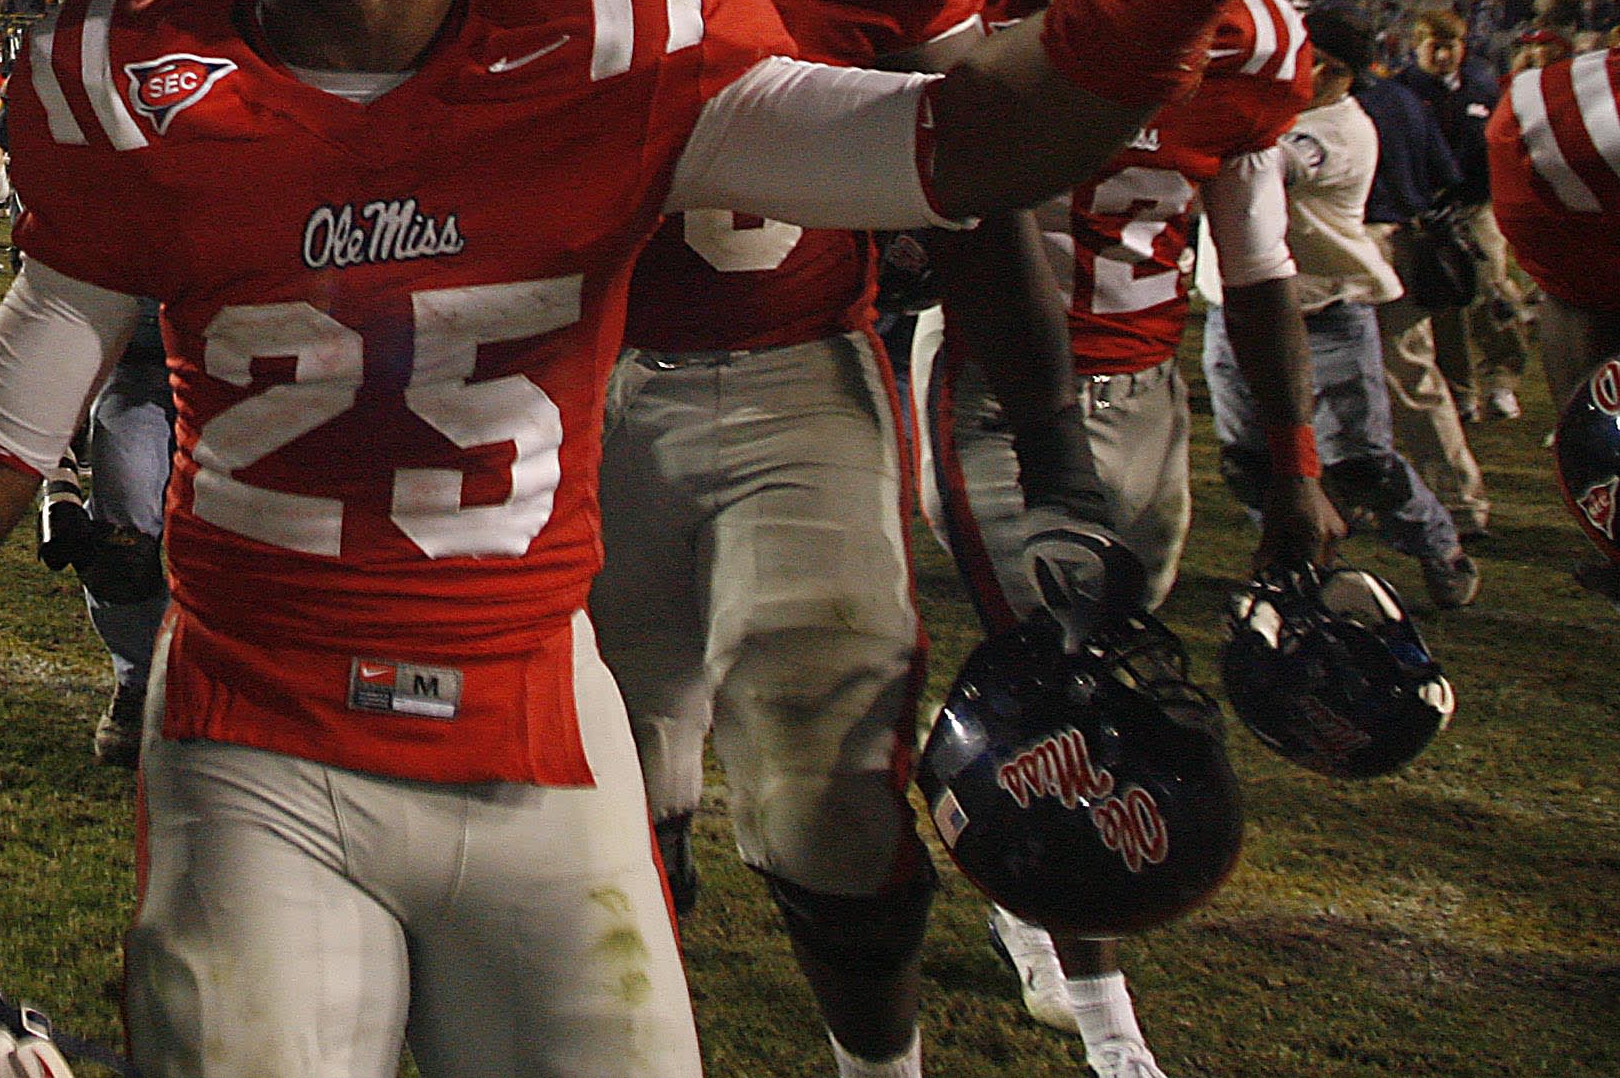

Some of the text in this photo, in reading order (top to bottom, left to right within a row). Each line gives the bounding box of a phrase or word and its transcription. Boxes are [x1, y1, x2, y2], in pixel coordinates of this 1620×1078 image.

[148, 71, 198, 98] SEC
[304, 198, 465, 269] Ole Miss
[1035, 165, 1196, 314] 2
[192, 274, 582, 559] 25
[413, 675, 440, 698] M
[996, 728, 1168, 872] Ole Miss
